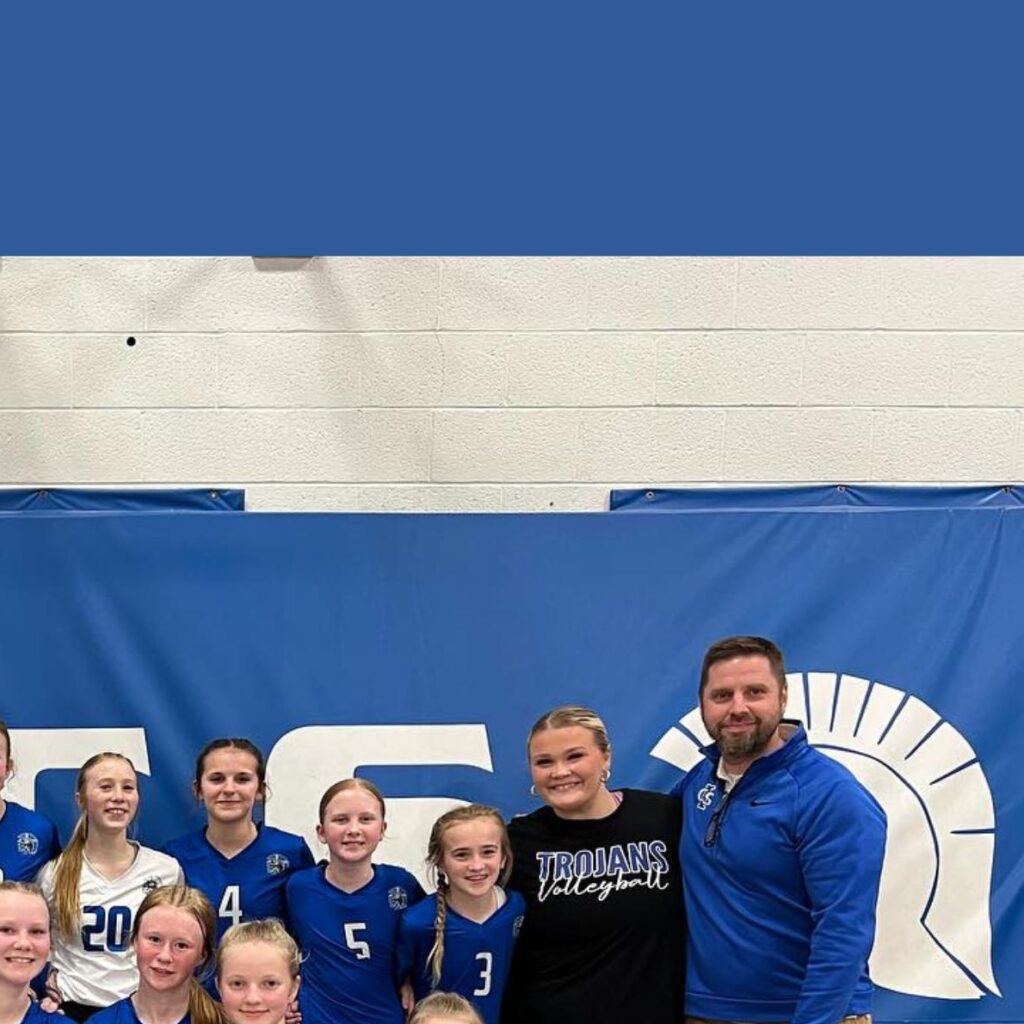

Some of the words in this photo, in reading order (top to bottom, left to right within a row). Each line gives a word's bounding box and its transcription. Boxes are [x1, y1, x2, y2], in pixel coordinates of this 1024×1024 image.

[536, 840, 670, 882] TROJANS
[537, 863, 670, 902] Volleyball
[218, 885, 243, 926] 4
[81, 905, 132, 952] 20
[344, 922, 371, 960] 5
[473, 952, 494, 996] 3
